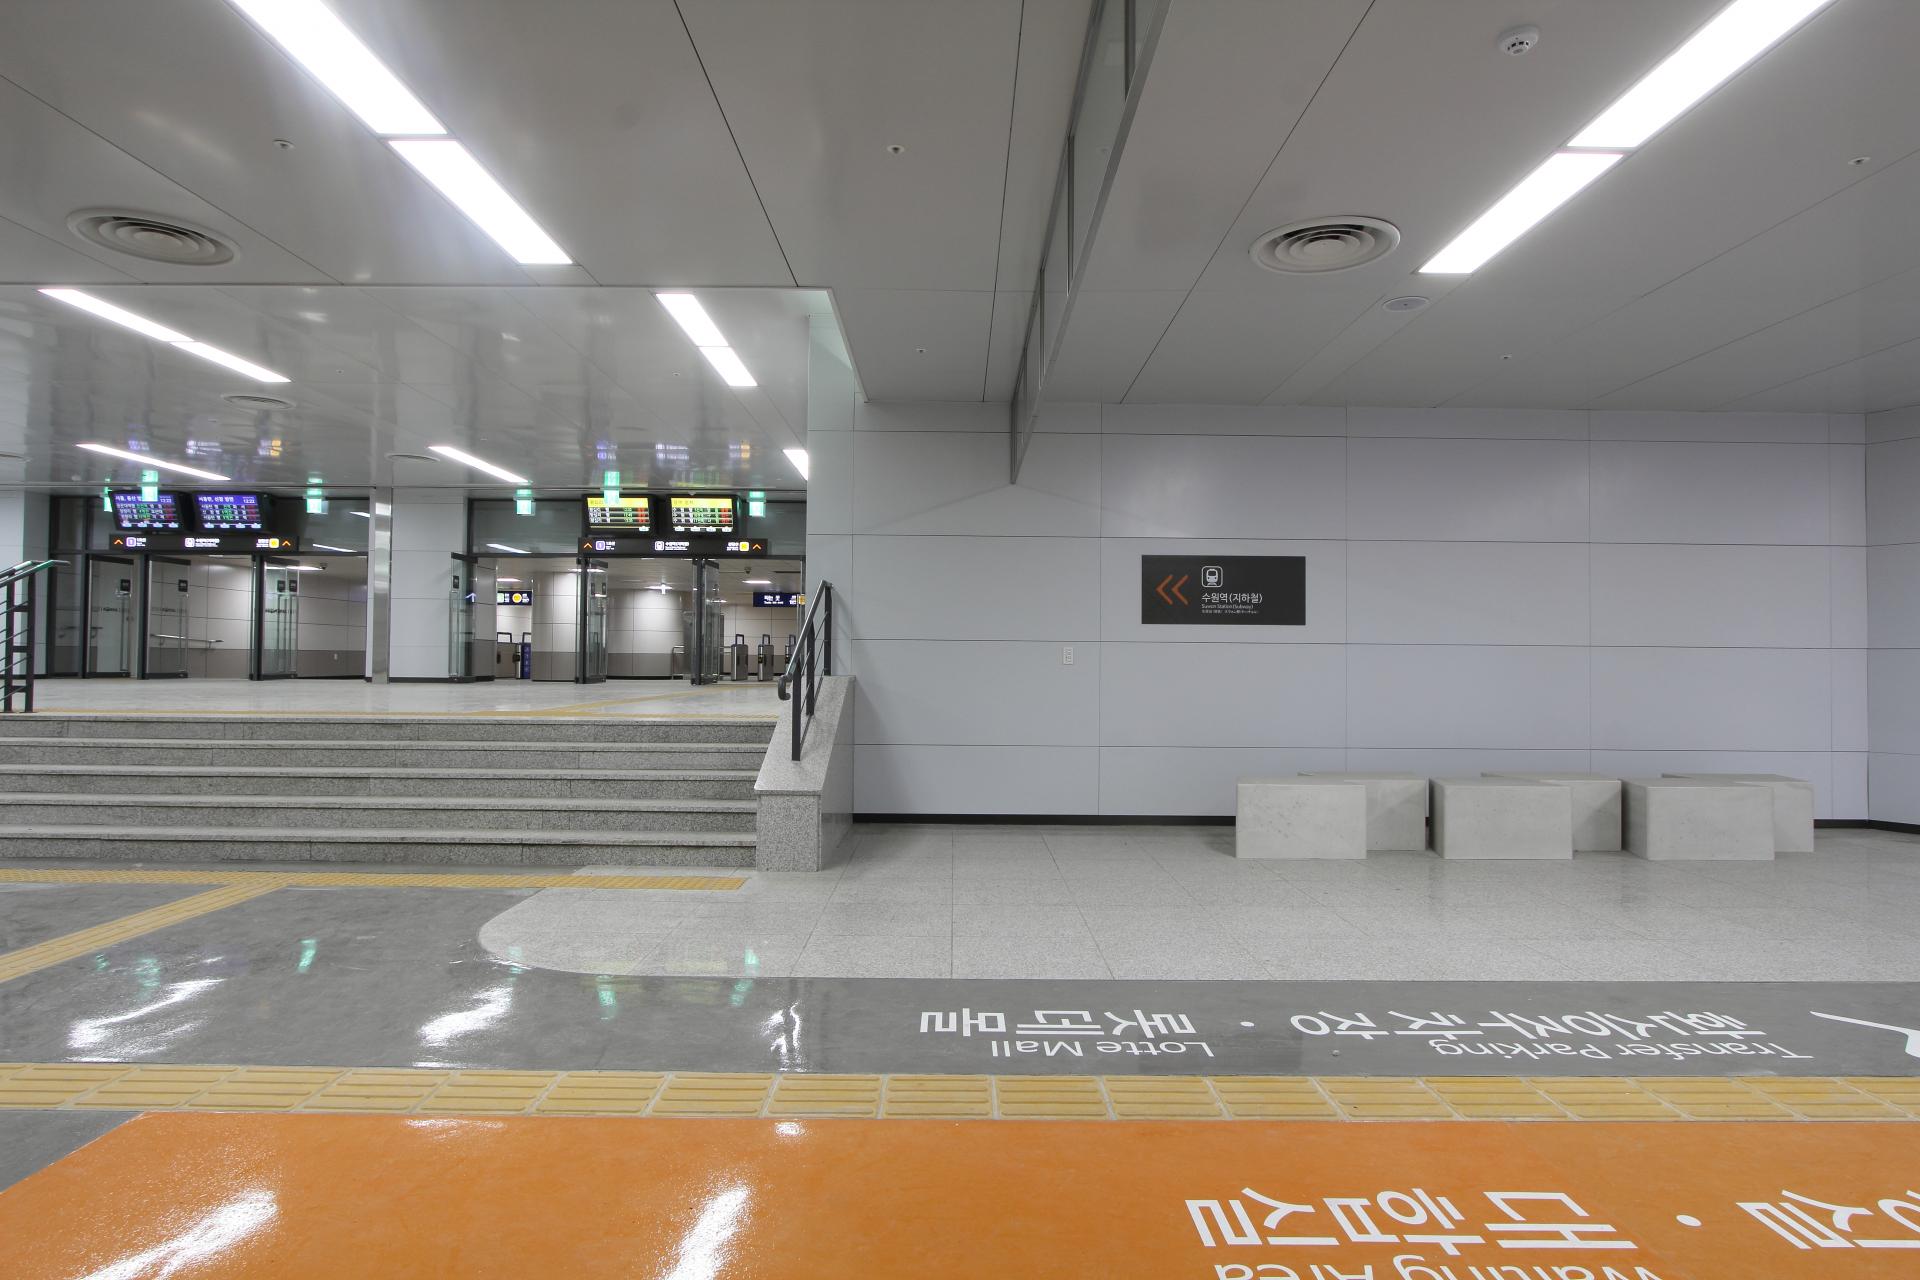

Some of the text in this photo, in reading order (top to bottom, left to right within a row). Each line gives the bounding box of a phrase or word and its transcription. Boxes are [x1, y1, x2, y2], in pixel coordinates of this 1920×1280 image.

[1201, 592, 1263, 604] 수원역(지하철)
[920, 1008, 1196, 1038] 롯데몰
[991, 1040, 1215, 1057] Lotte Mall
[1428, 1039, 1815, 1060] Transfer Parking
[1185, 1187, 1638, 1256] 대합실
